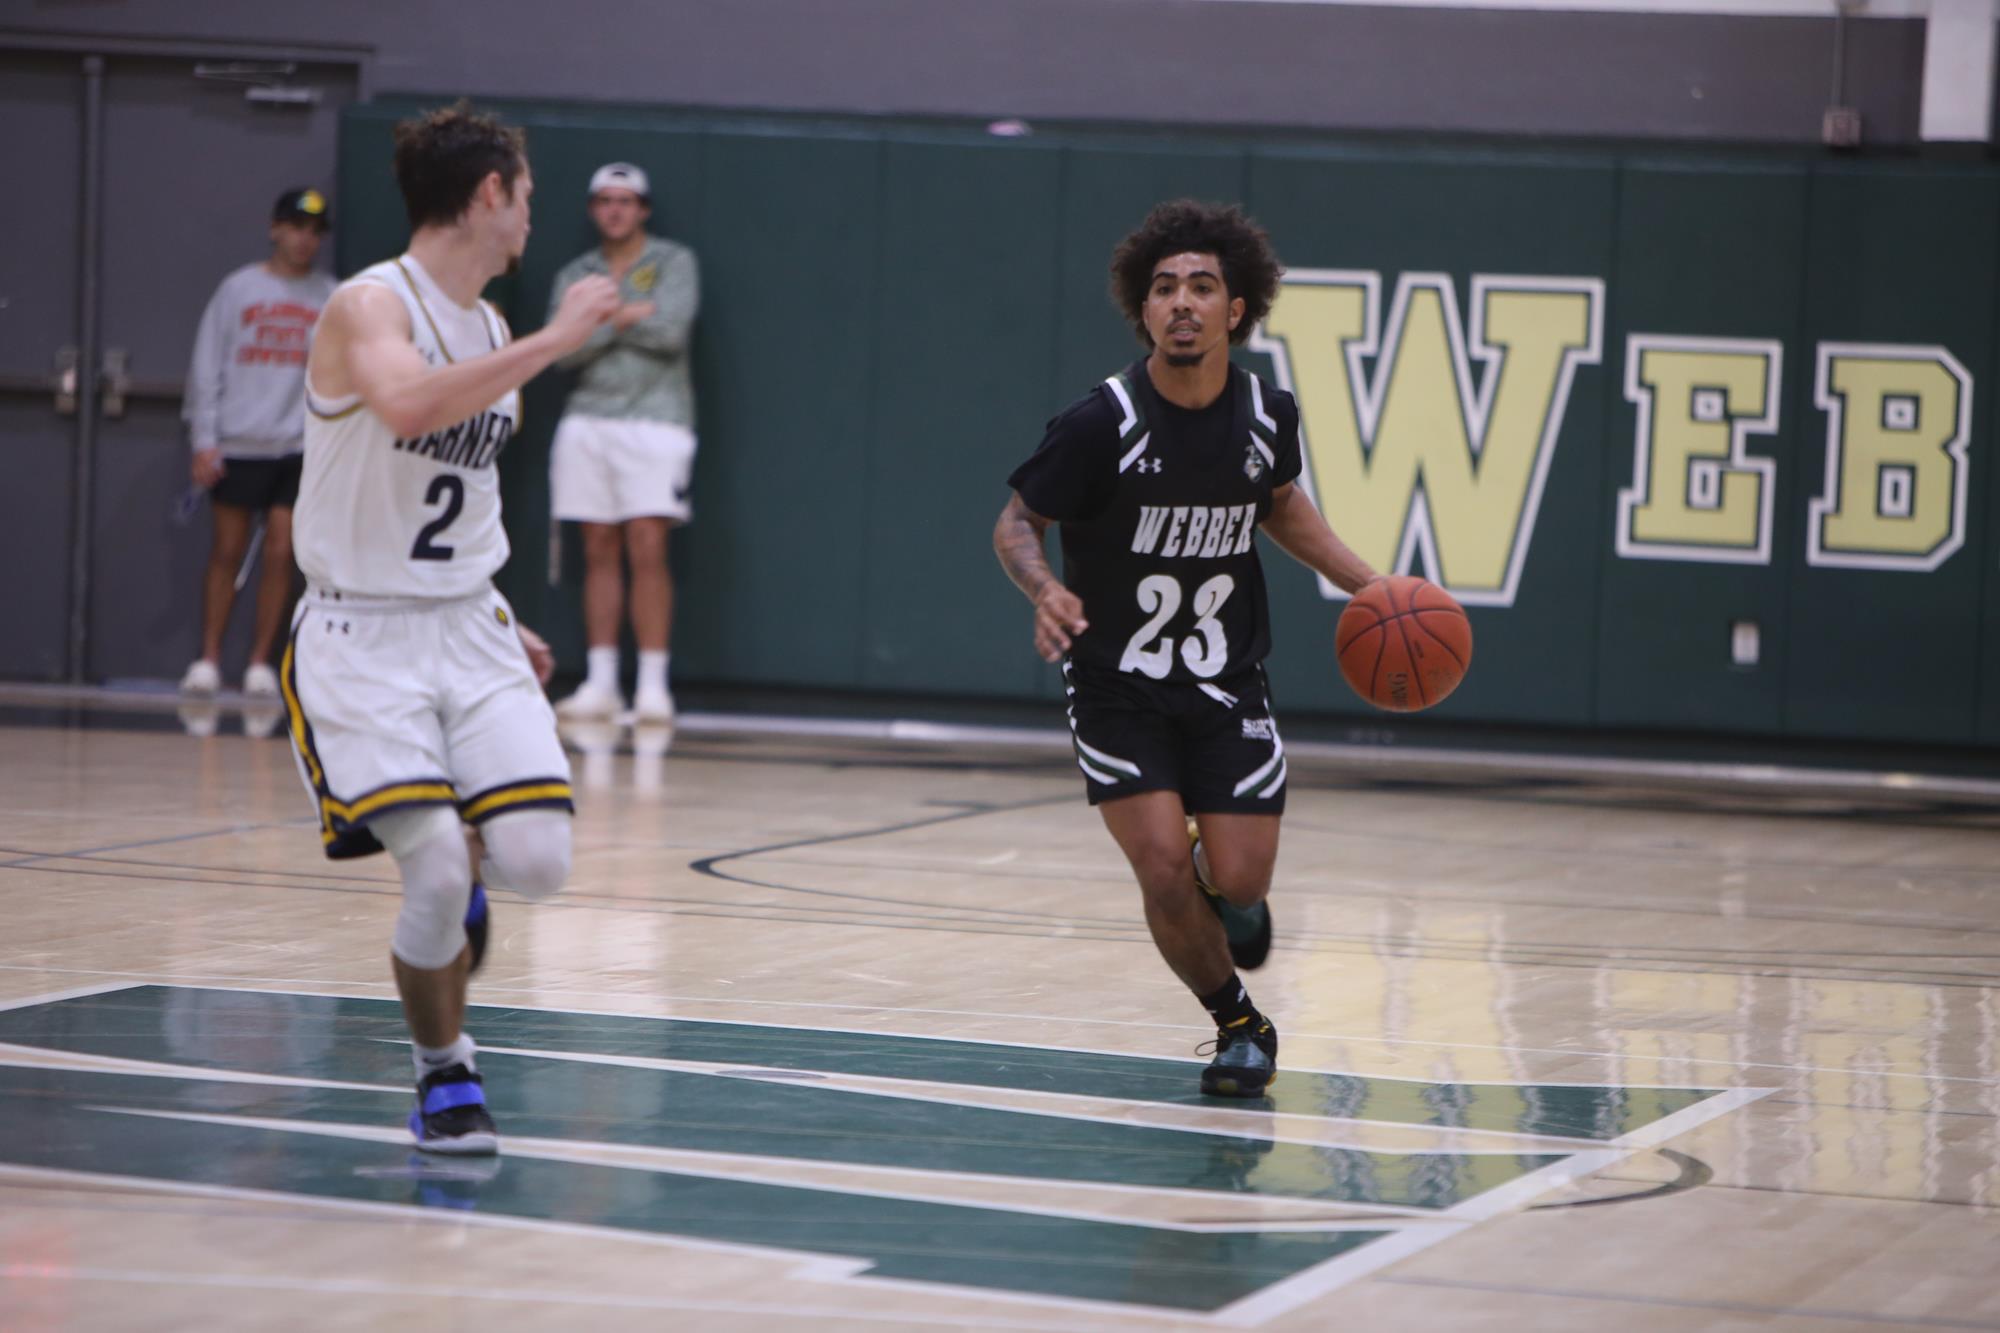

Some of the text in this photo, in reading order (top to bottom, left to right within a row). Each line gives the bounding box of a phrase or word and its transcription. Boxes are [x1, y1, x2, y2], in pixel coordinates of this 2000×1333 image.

[1249, 267, 1973, 607] WEB
[410, 474, 465, 561] 2
[1131, 502, 1257, 558] WEBBER
[1118, 573, 1235, 680] 23
